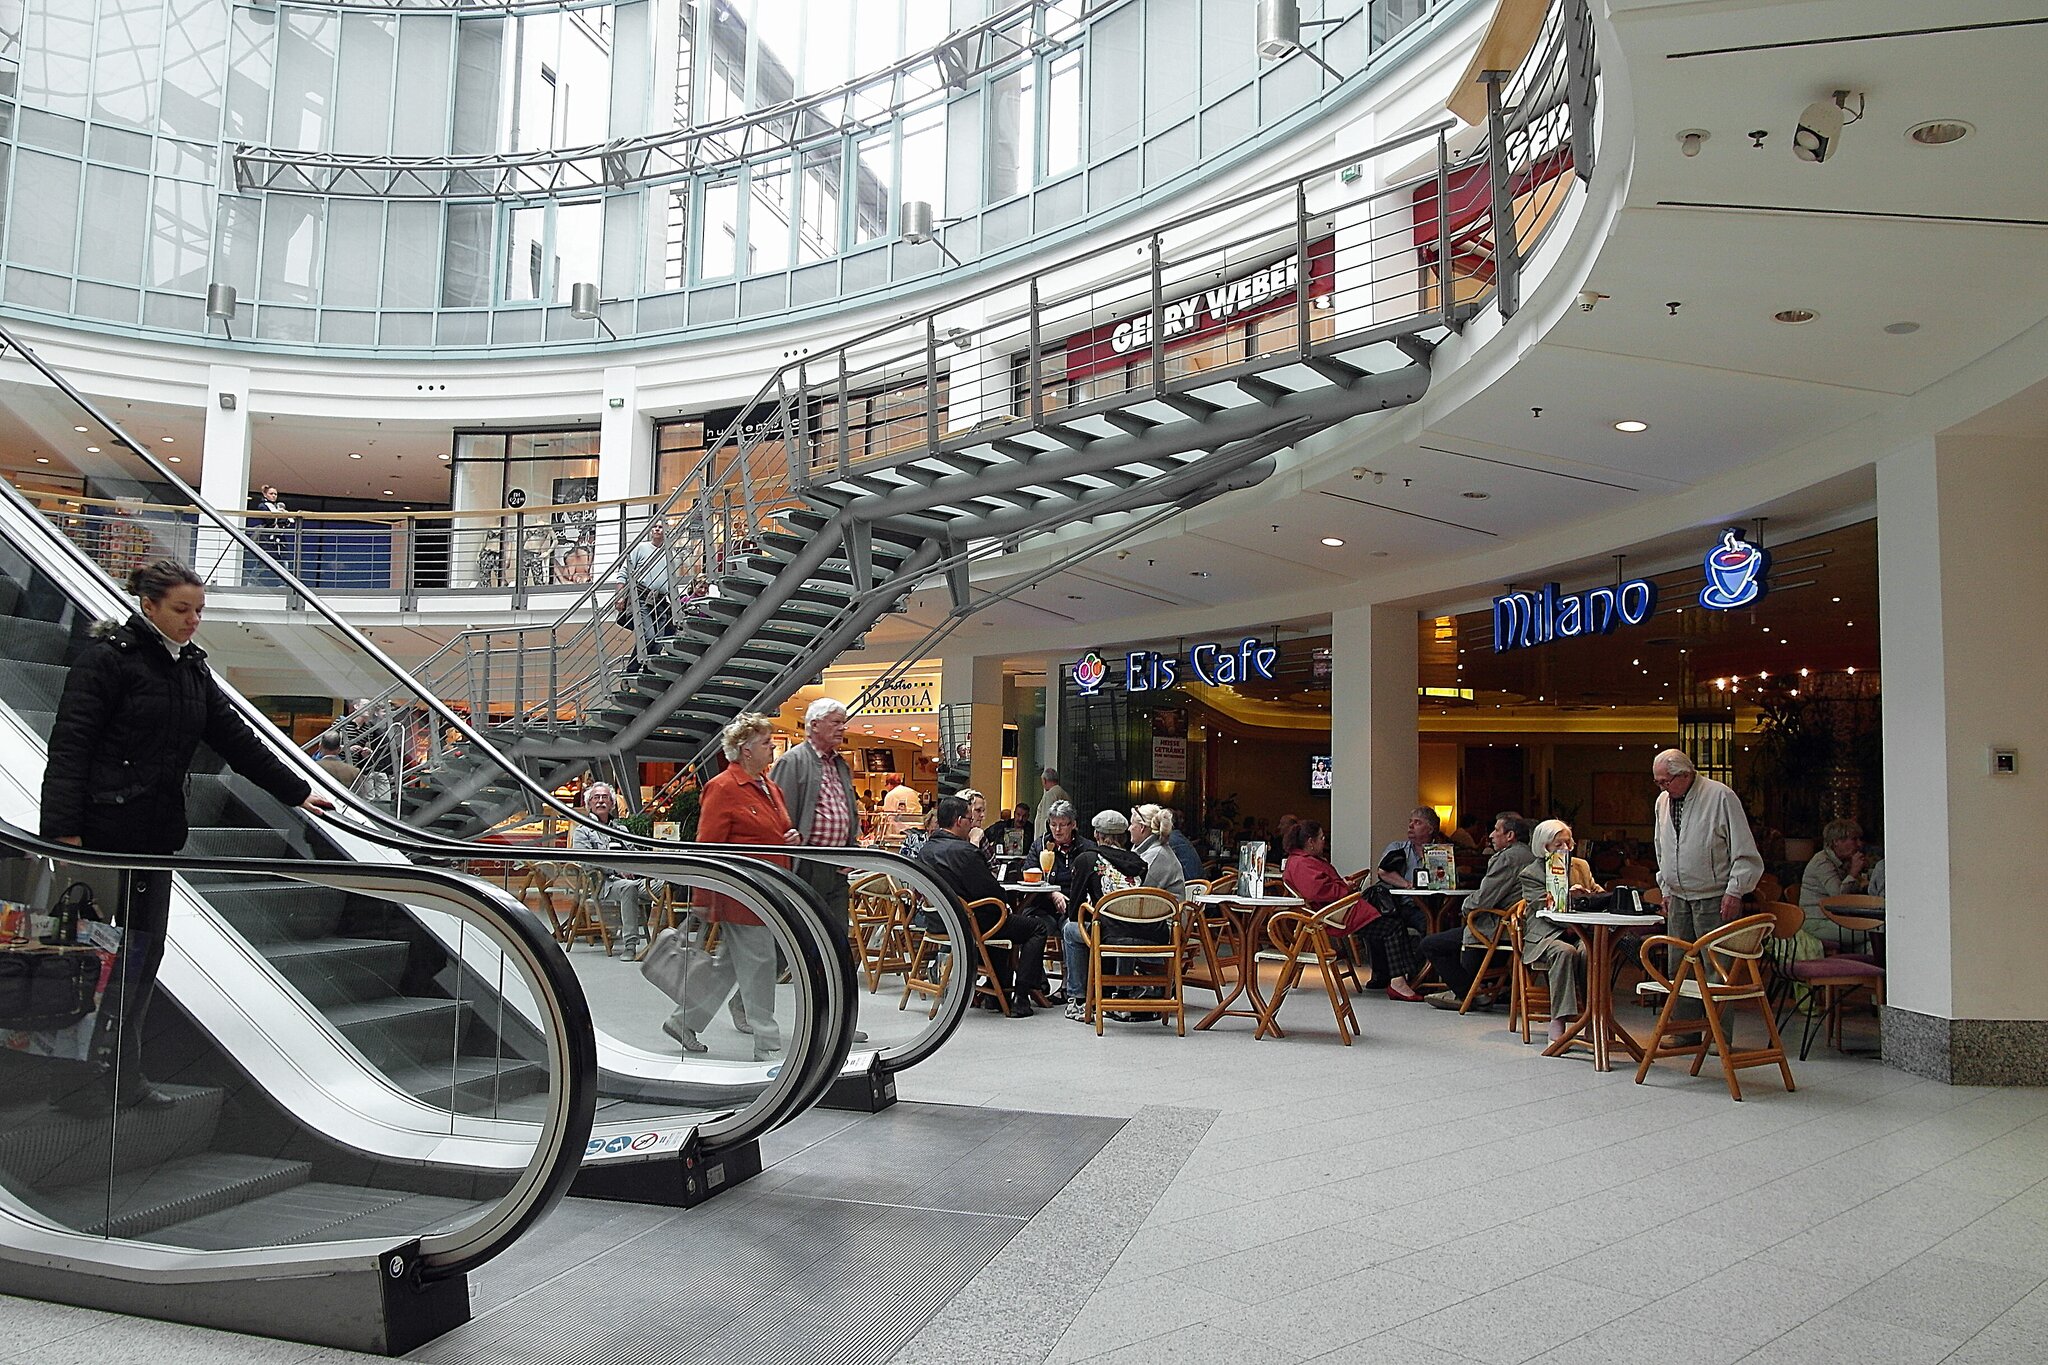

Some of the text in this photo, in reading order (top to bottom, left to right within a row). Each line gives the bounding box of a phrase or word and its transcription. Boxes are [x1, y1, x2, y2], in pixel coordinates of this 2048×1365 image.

[1492, 579, 1658, 655] Milano
[1126, 650, 1180, 693] Eis
[1189, 636, 1281, 688] Cafe
[862, 689, 932, 708] PORTOLA
